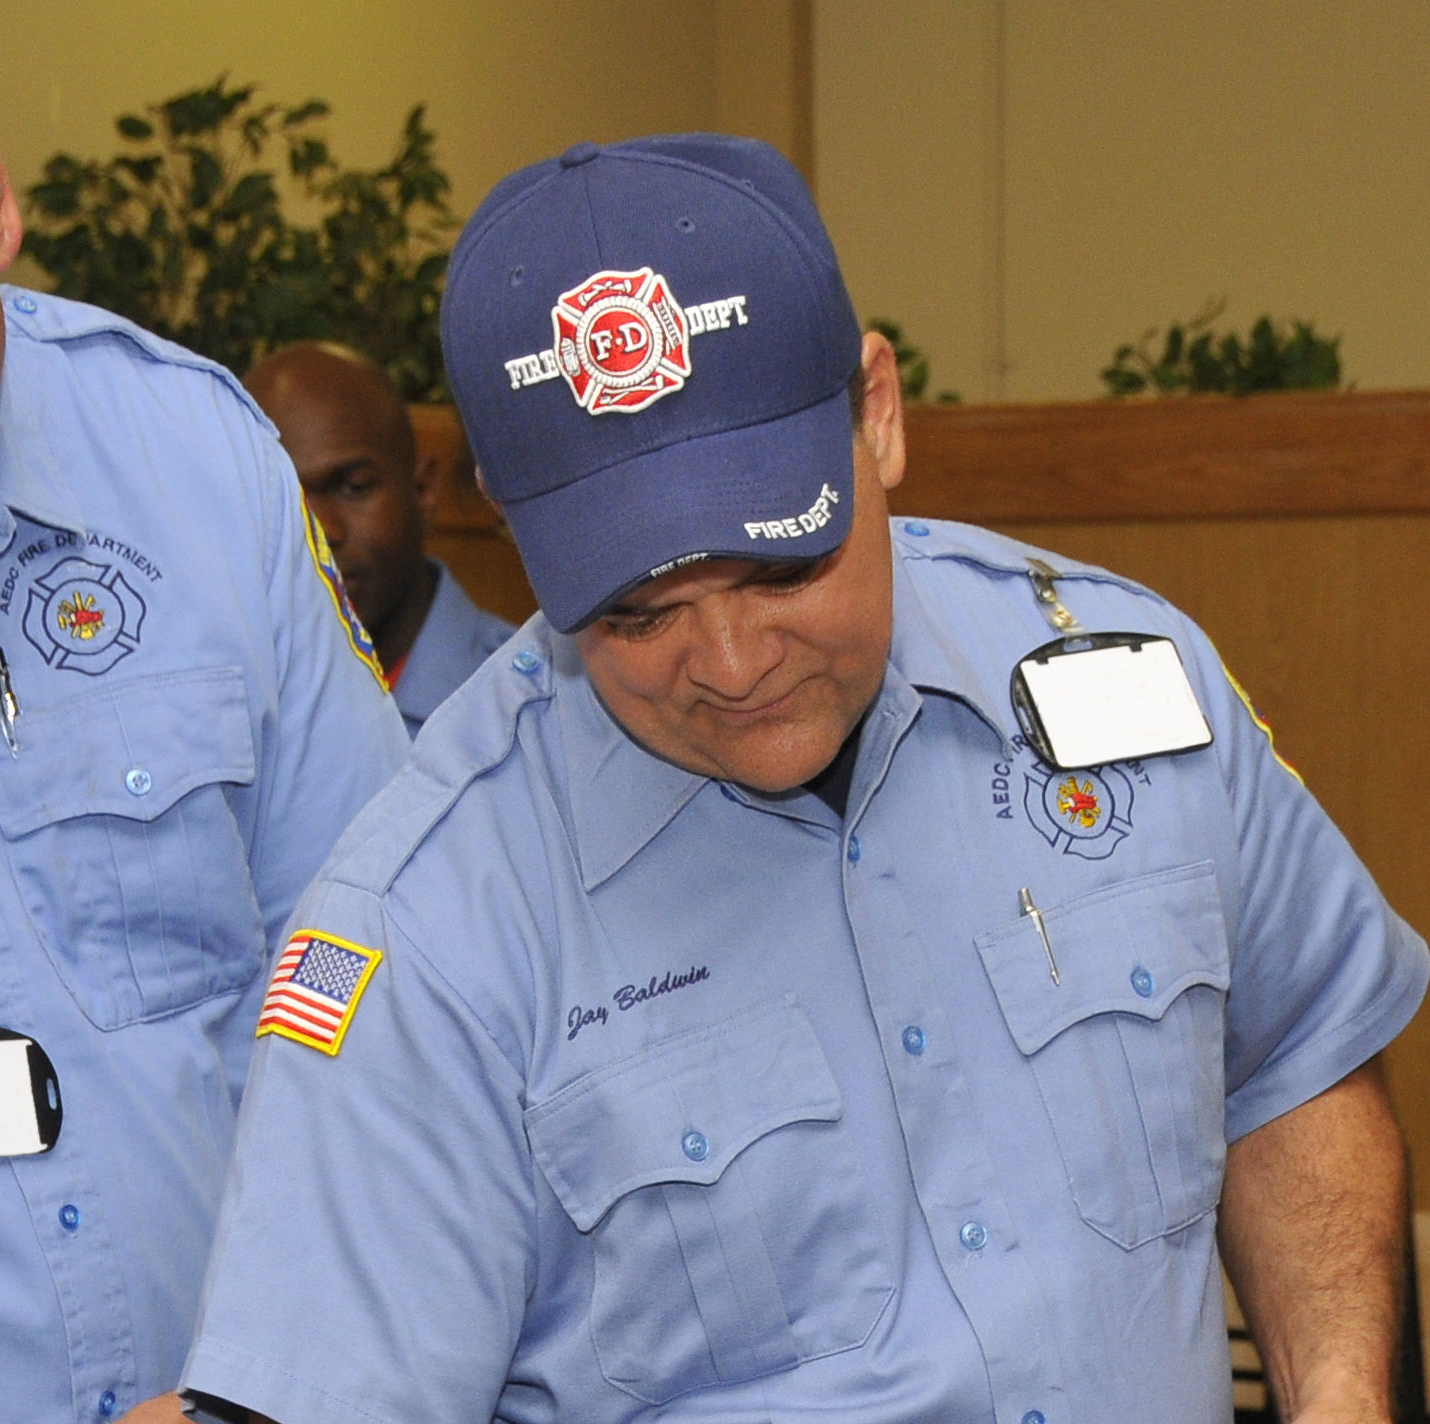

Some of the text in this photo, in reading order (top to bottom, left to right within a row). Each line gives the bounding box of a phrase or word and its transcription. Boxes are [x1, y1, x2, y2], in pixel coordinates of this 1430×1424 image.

[504, 295, 749, 391] FIRE DEPT
[743, 517, 804, 540] FIRE
[17, 540, 52, 567] FIRE
[54, 531, 163, 583] DEARTMENT
[650, 561, 676, 579] FIRE
[991, 762, 1014, 820] AEDC
[567, 965, 711, 1041] Jay Baldwin
